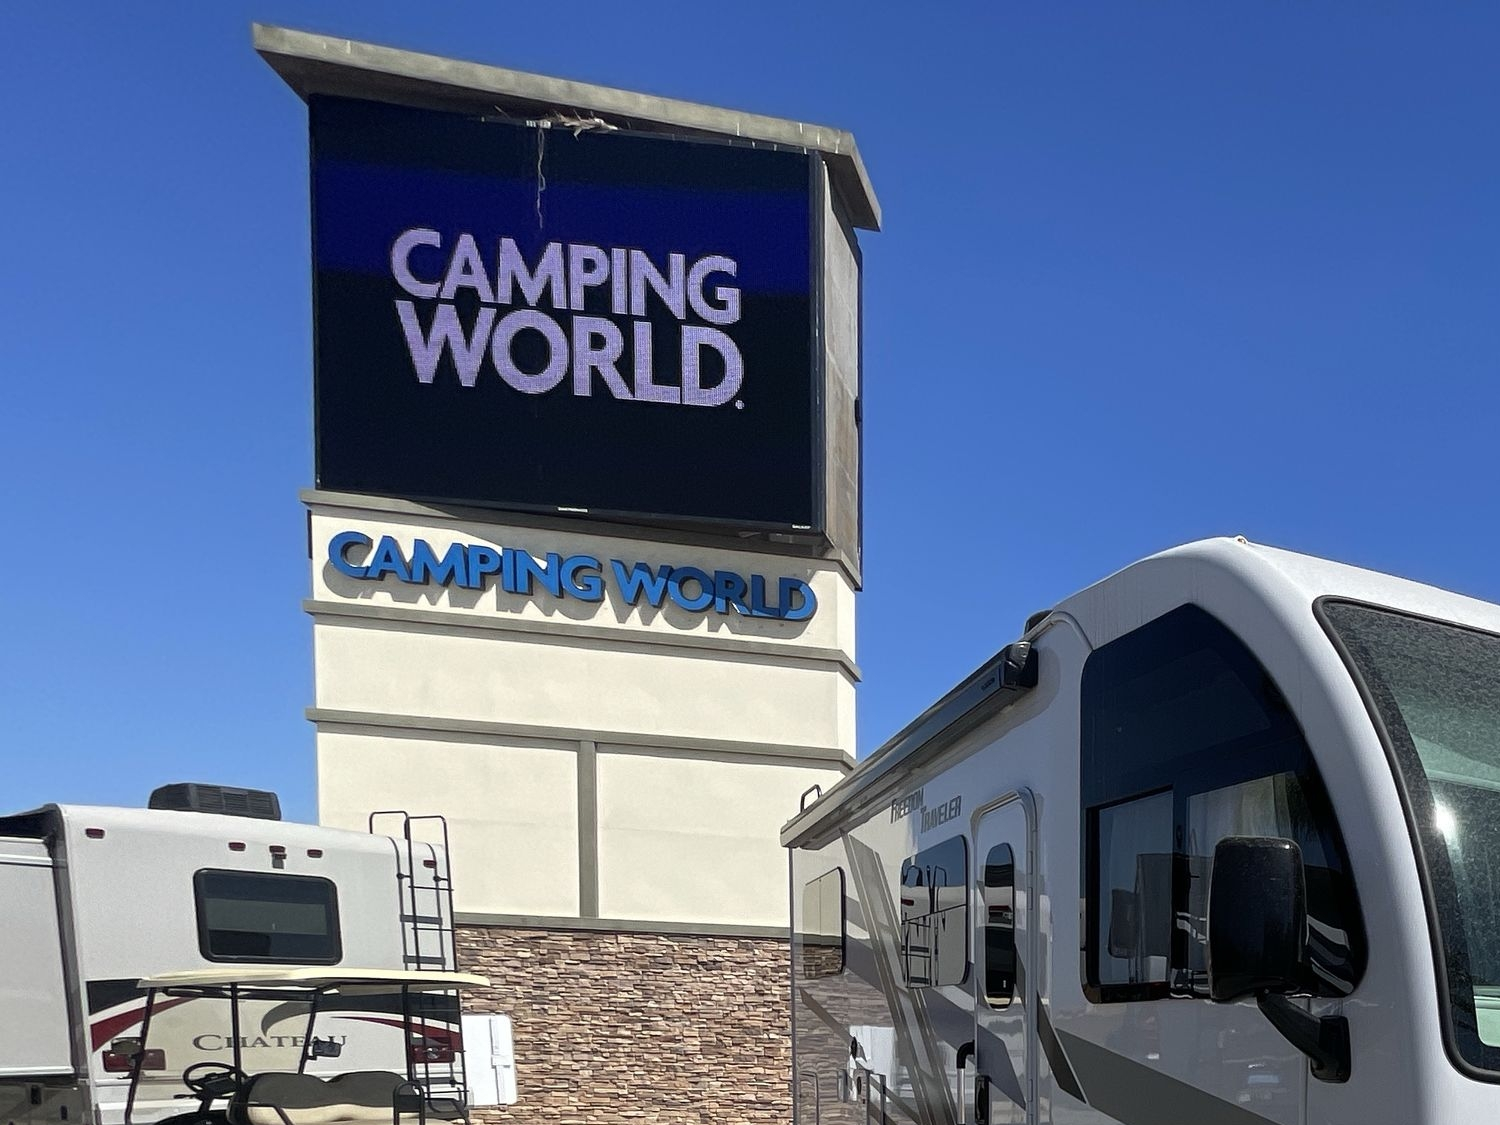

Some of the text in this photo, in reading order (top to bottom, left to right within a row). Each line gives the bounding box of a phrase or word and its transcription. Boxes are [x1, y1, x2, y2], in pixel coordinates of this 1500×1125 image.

[389, 227, 742, 326] CAMPING
[328, 531, 818, 622] CAMPING WORLD
[890, 787, 924, 825] FREEDOM
[920, 795, 962, 834] TRAVELER
